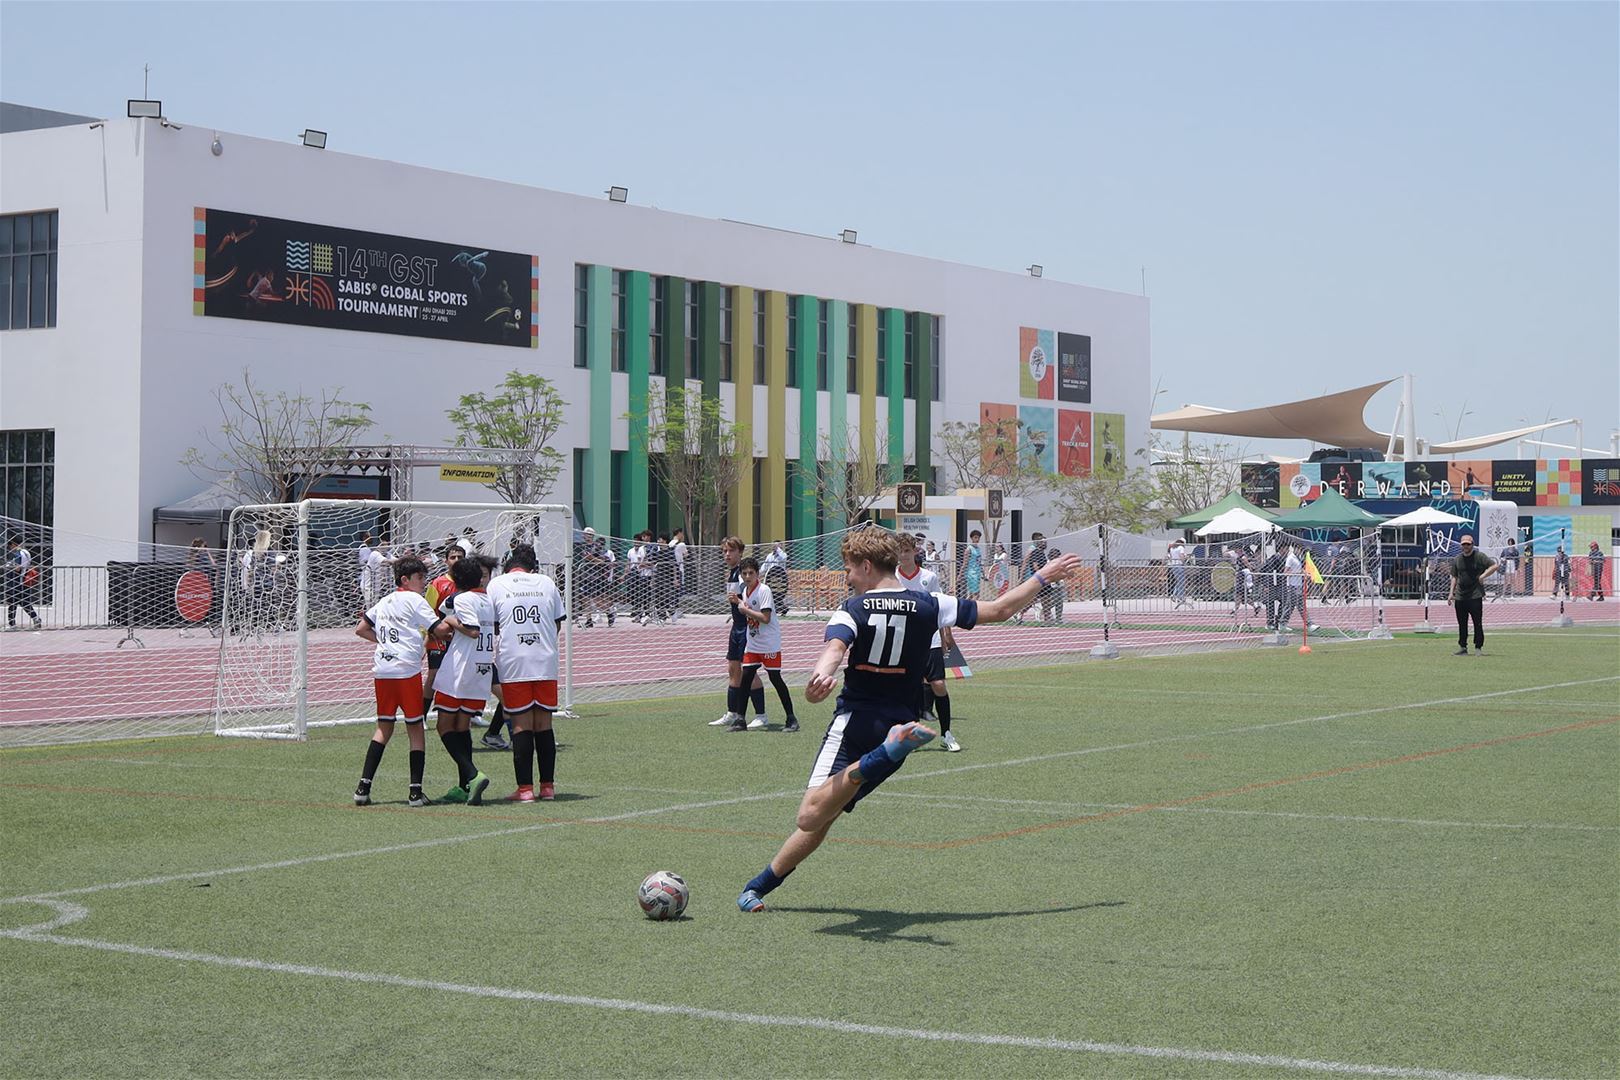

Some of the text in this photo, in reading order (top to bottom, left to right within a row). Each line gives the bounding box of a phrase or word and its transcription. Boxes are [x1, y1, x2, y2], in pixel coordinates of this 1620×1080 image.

[388, 253, 438, 287] GST
[380, 284, 425, 302] GLOBAL
[427, 291, 468, 306] SPORTS
[338, 298, 419, 319] TOURNAMENT
[442, 468, 496, 478] INFORMATION
[512, 605, 541, 624] 04
[862, 598, 918, 613] STEINMETZ
[476, 632, 494, 652] 11
[867, 613, 907, 666] 11
